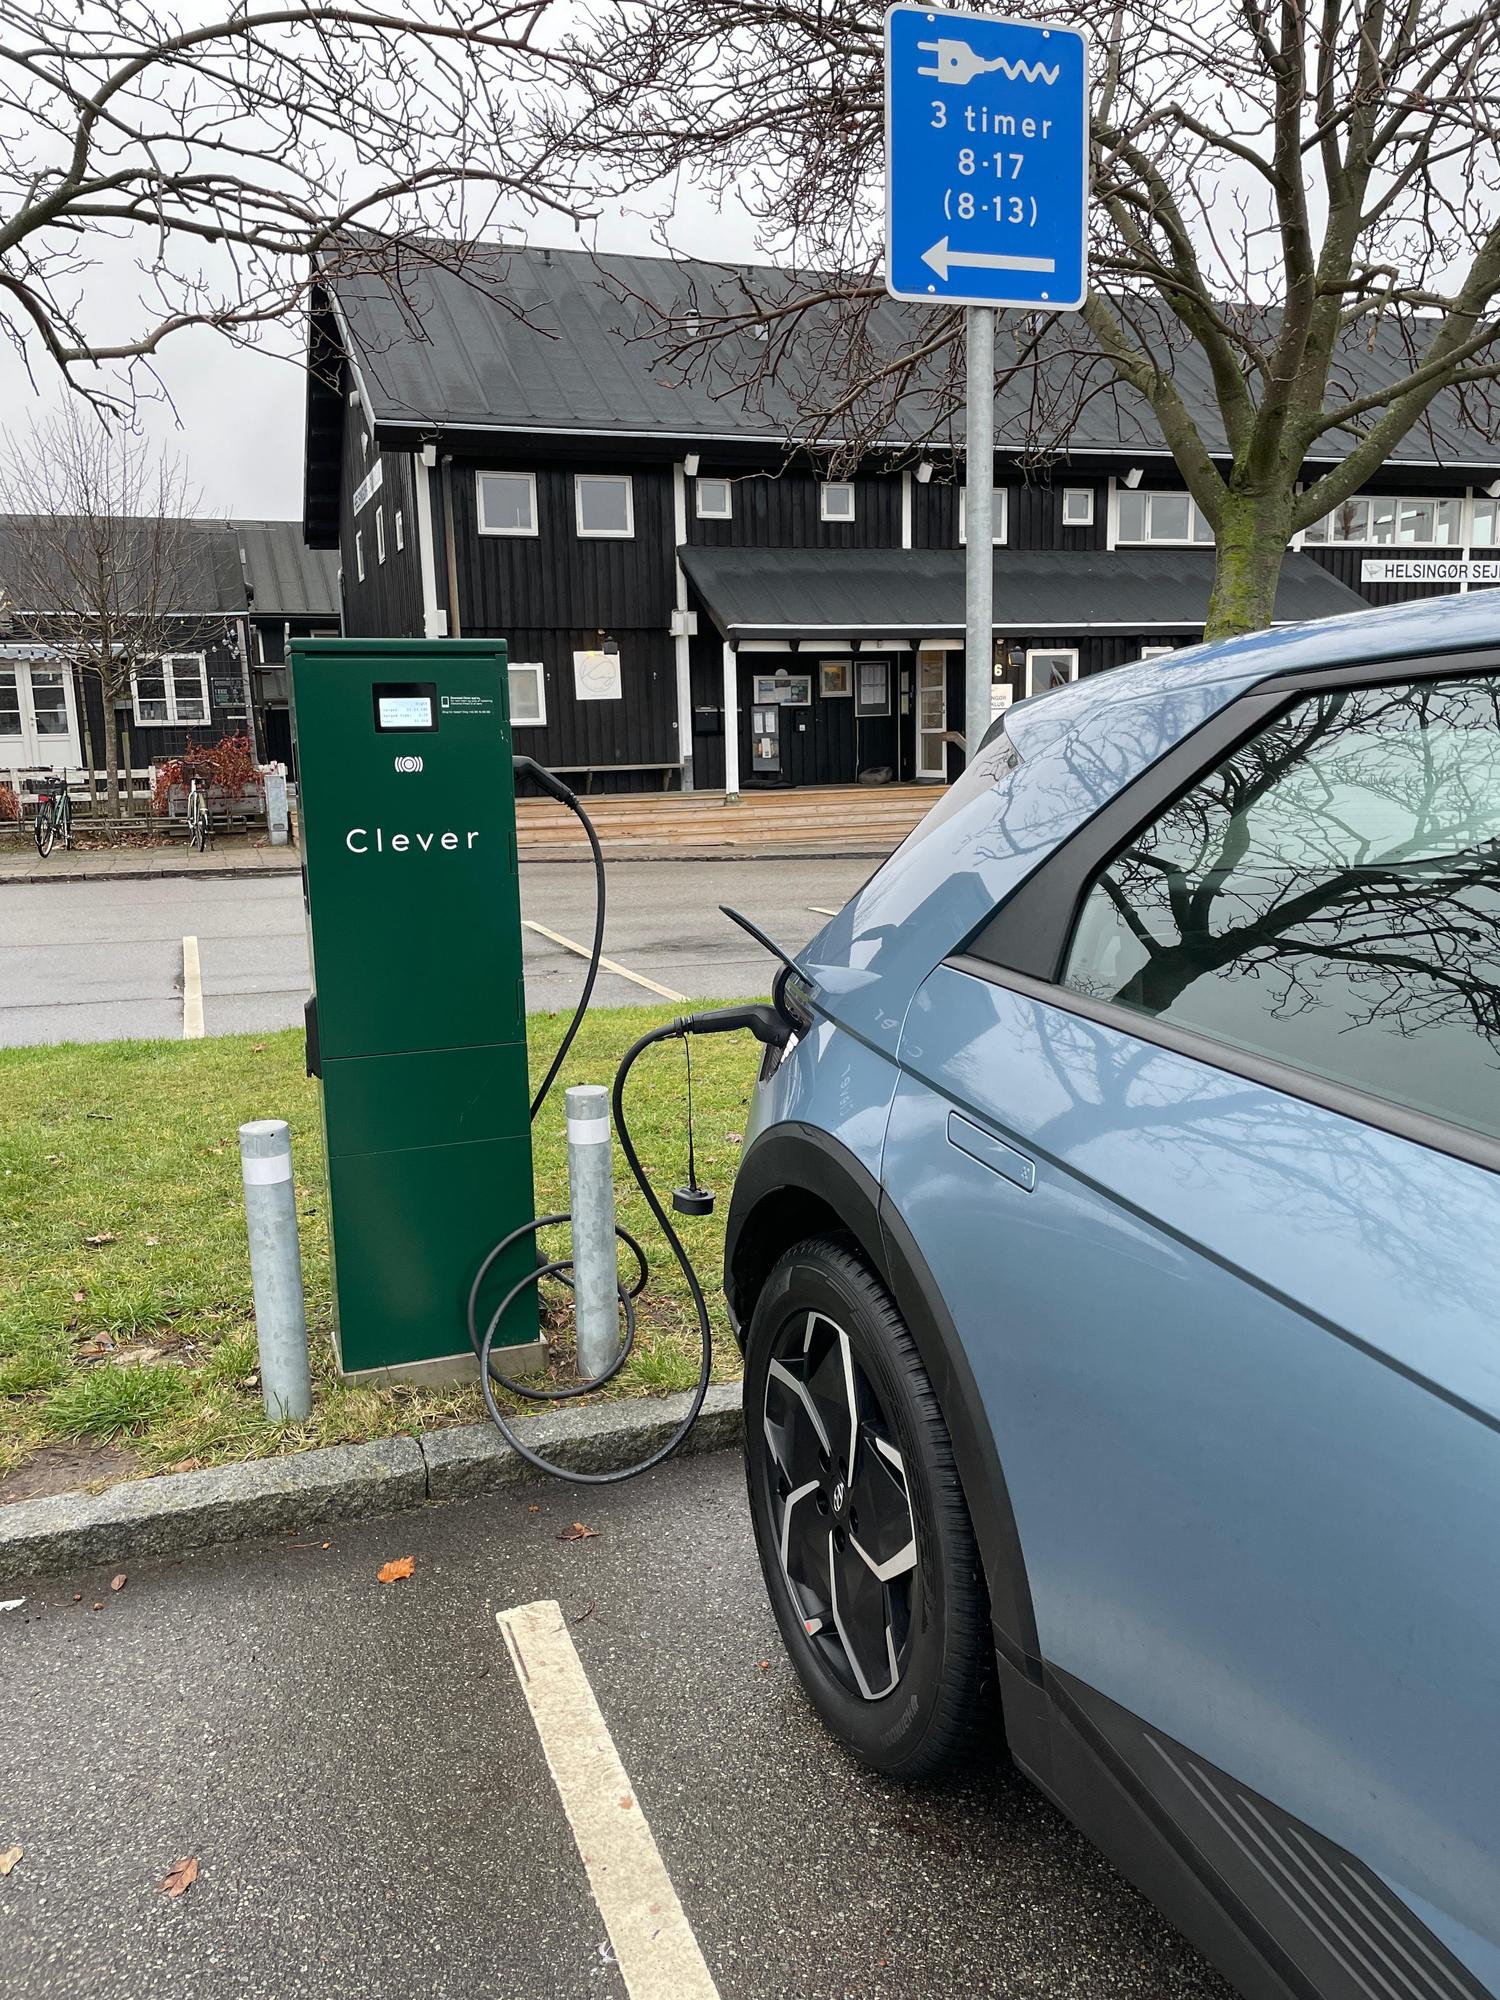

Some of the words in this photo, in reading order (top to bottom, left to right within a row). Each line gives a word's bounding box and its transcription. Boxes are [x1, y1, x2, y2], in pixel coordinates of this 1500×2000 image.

[930, 101, 947, 129] 3
[964, 105, 1053, 139] timer
[1384, 564, 1468, 579] HELSINGØR
[1472, 564, 1500, 579] SEJ
[994, 664, 1003, 676] 6
[346, 828, 479, 853] Clever
